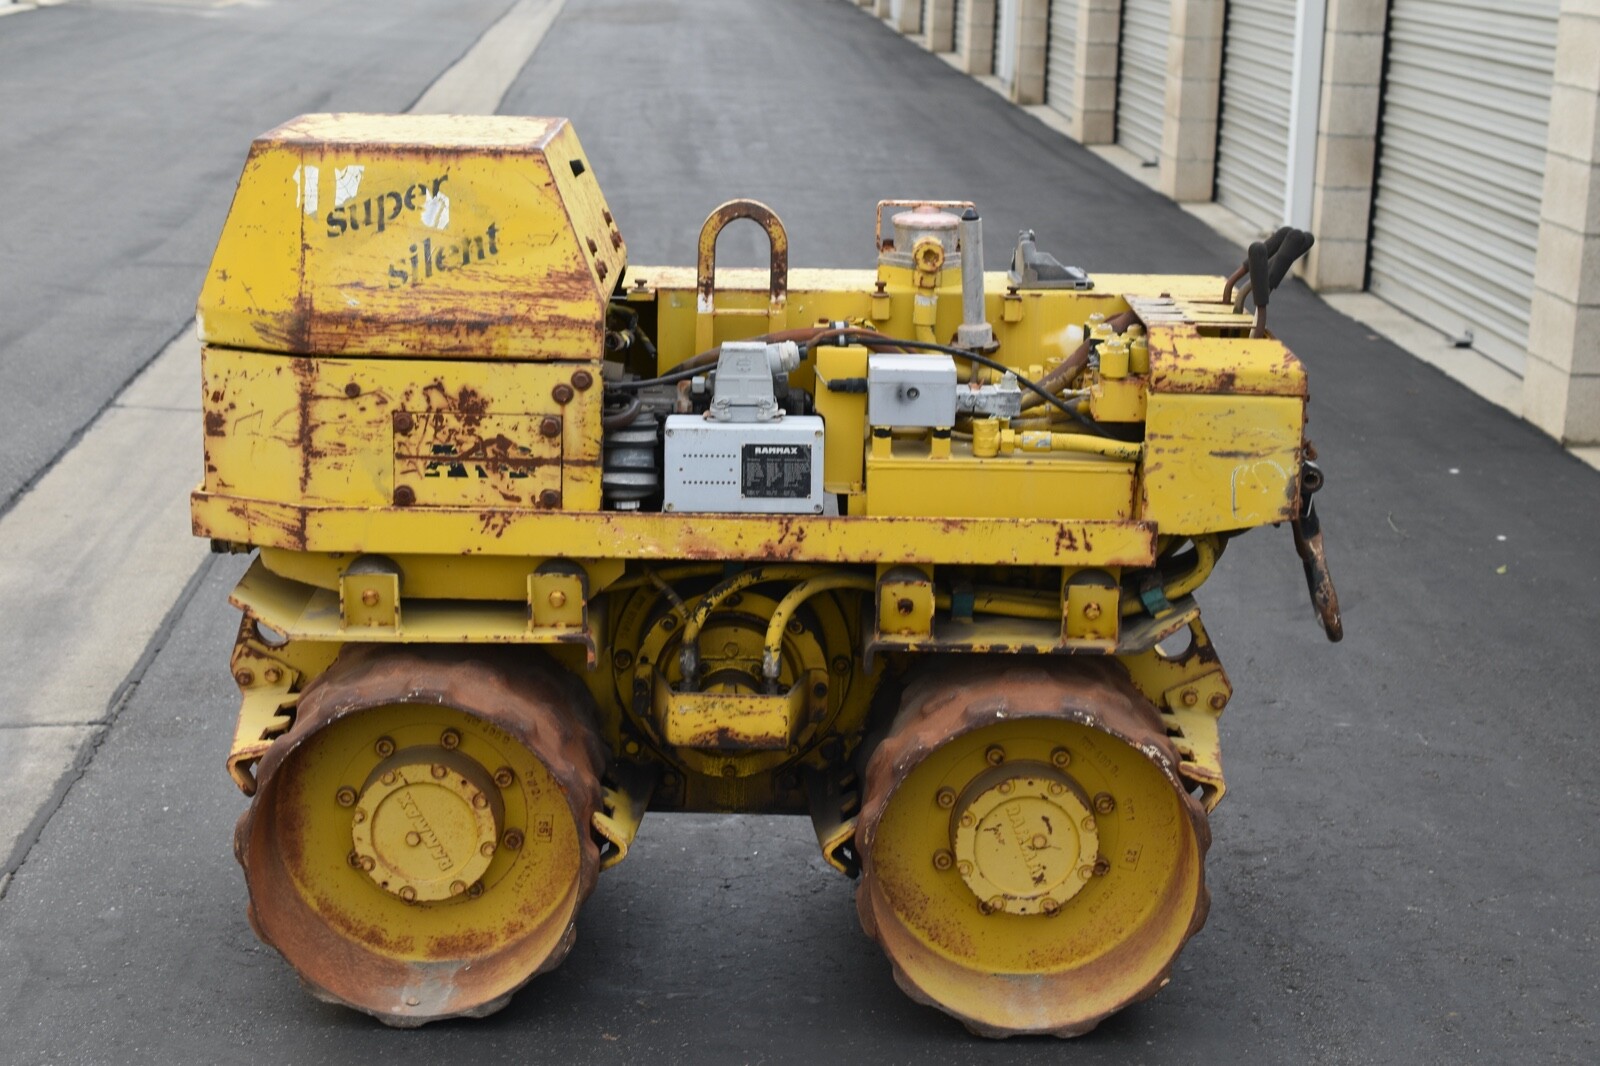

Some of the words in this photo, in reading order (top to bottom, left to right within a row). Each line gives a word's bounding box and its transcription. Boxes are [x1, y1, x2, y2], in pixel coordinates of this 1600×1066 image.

[326, 174, 449, 238] super
[388, 222, 499, 289] silent
[754, 446, 798, 455] RAMMAX
[398, 790, 454, 872] RAMMAX
